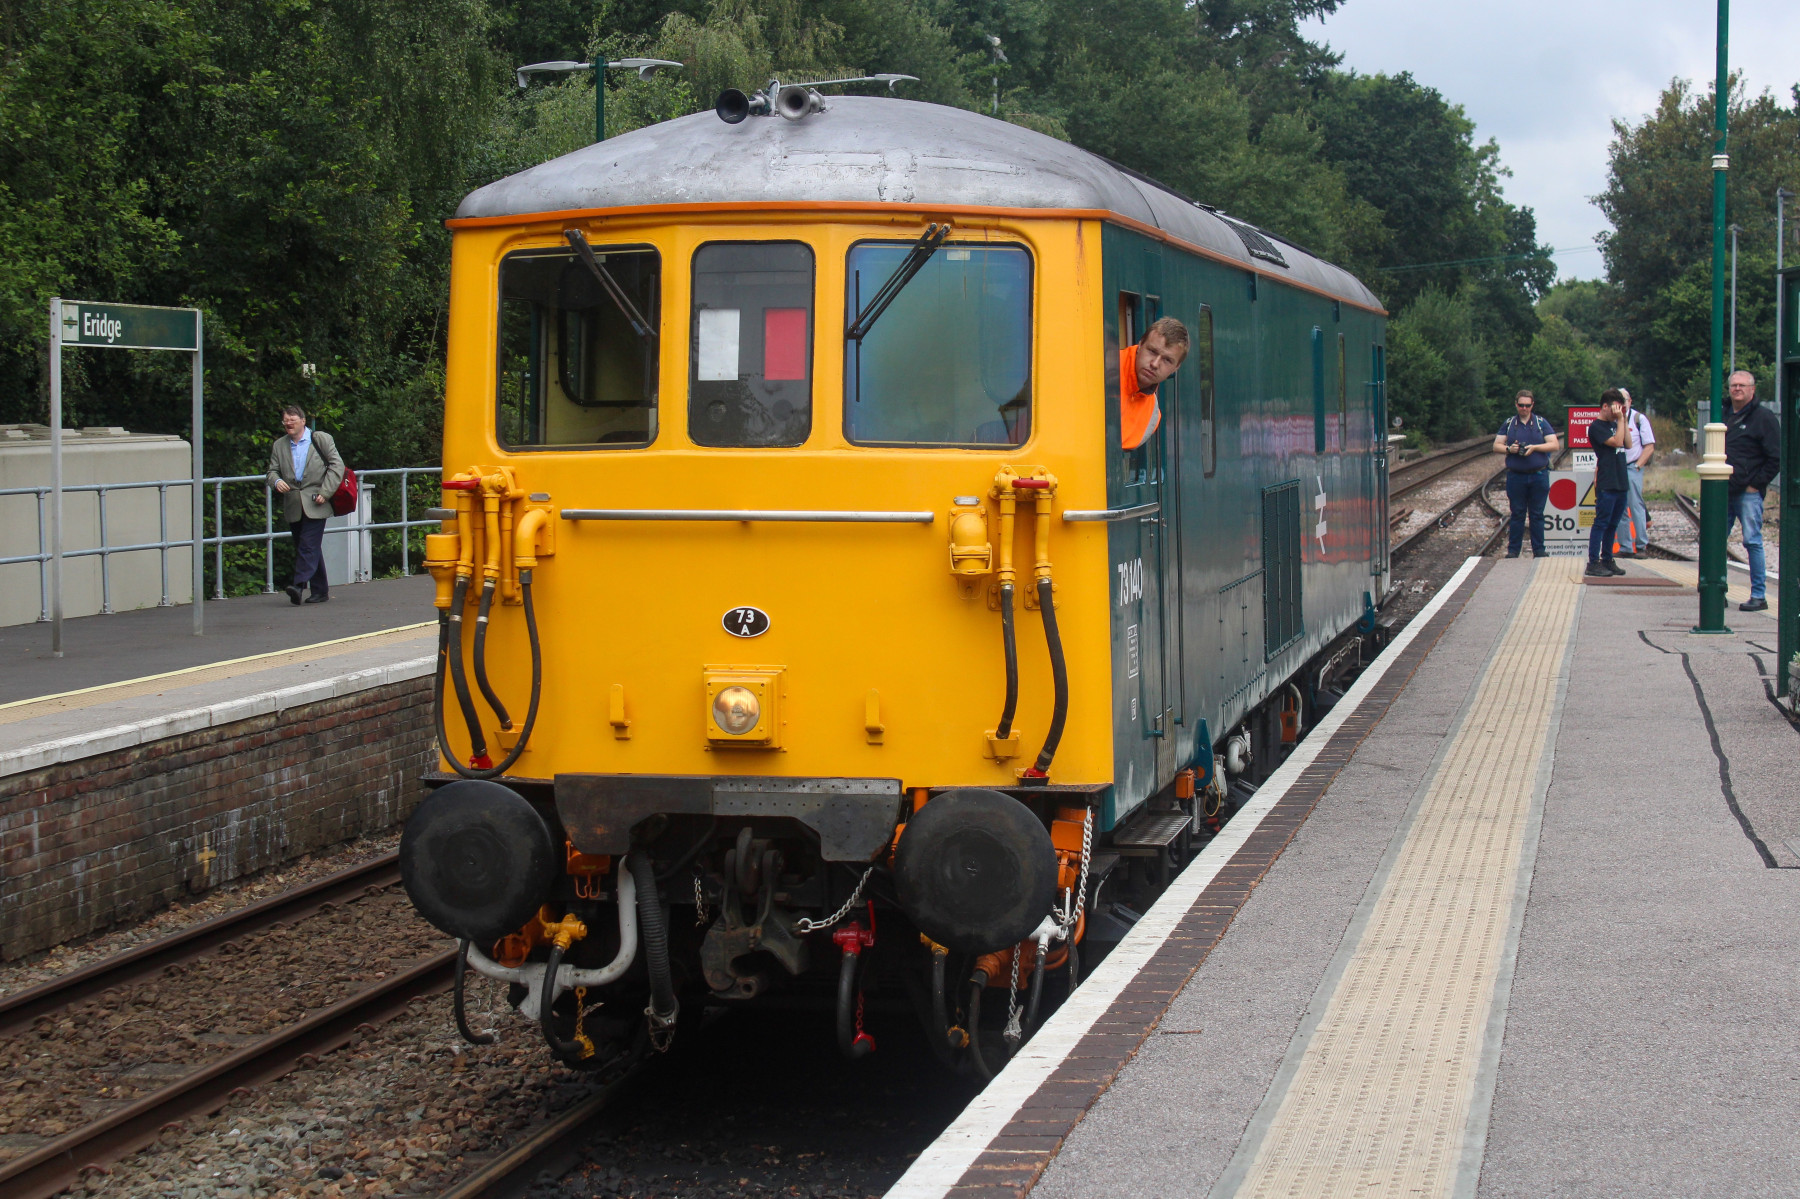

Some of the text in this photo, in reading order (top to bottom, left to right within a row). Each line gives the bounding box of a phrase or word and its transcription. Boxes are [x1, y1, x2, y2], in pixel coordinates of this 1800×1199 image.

[84, 312, 122, 343] Eridge
[1576, 454, 1595, 463] TALK
[1543, 514, 1580, 534] Sto
[736, 609, 755, 624] 73
[740, 623, 751, 635] A
